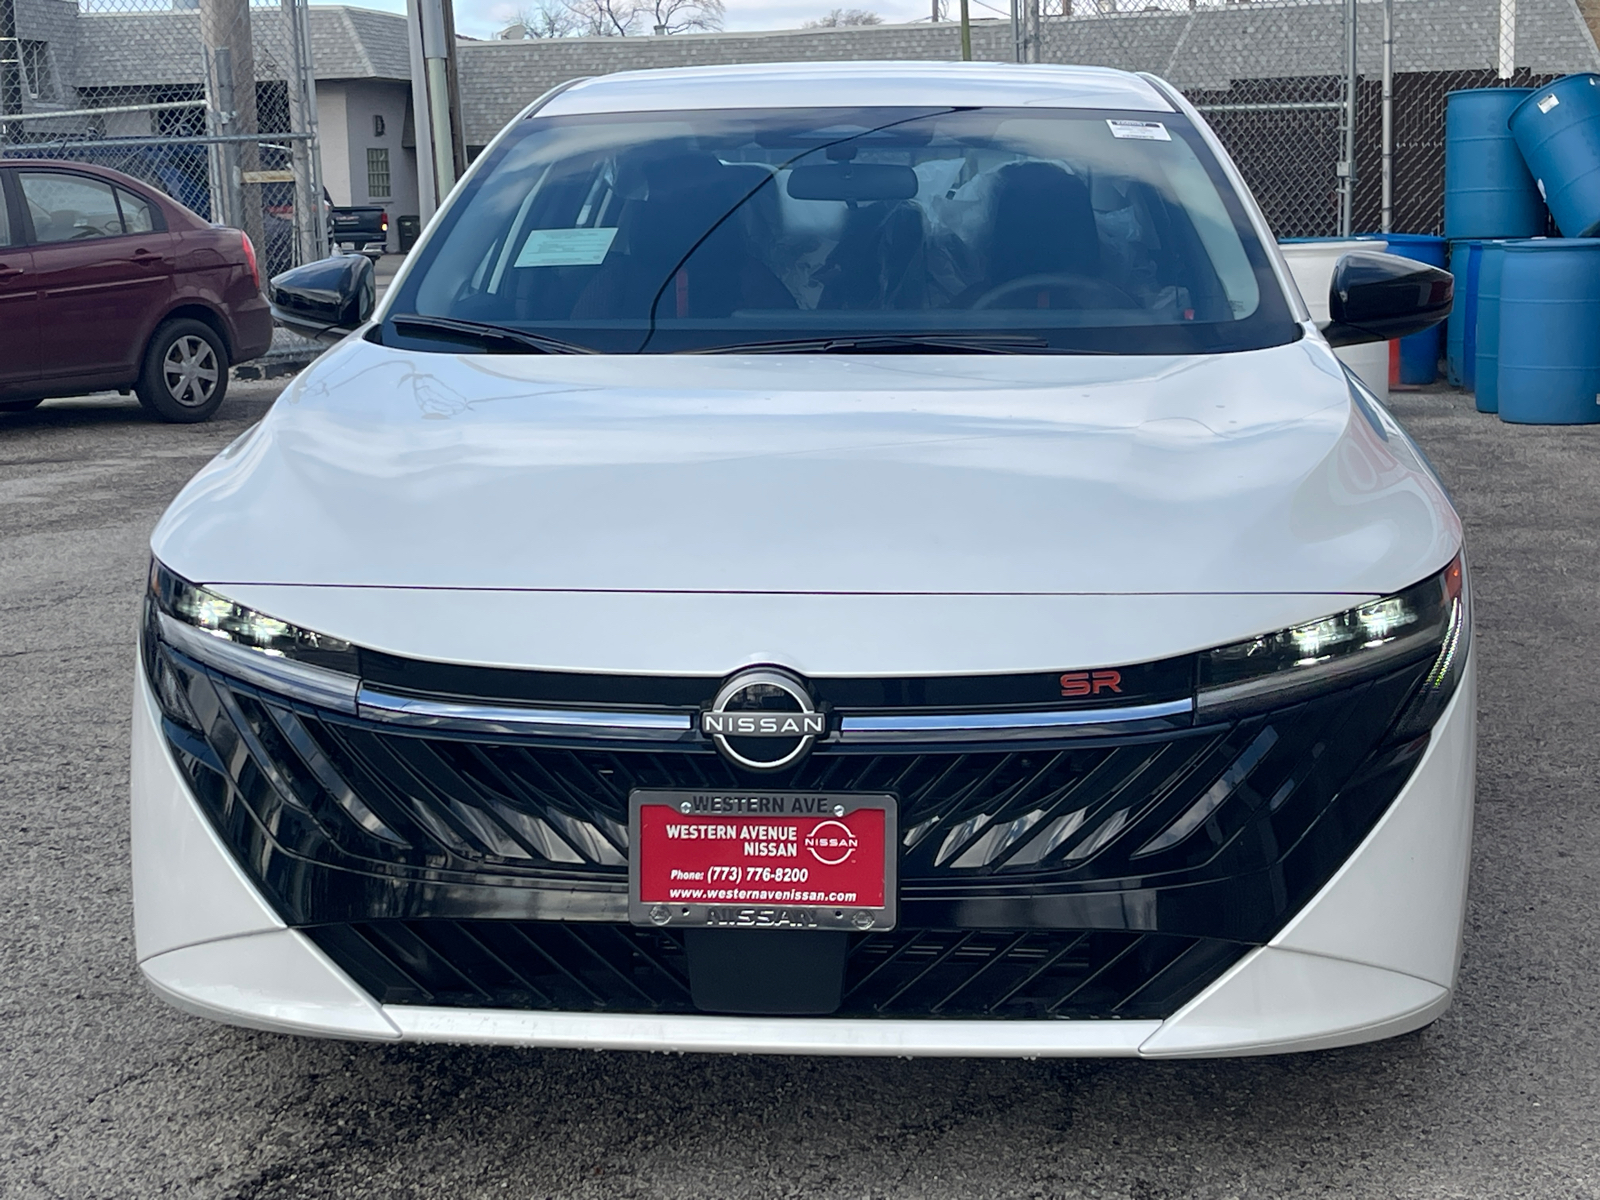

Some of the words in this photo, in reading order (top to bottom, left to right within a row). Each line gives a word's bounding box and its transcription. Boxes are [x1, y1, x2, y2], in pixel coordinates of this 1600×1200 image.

[1060, 670, 1122, 696] SR
[705, 716, 822, 733] NISSAN
[692, 796, 784, 813] WESTERN
[791, 797, 833, 814] AVE.
[666, 824, 737, 840] WESTERN
[740, 825, 797, 841] AVENUE
[744, 842, 797, 857] NISSAN
[804, 838, 858, 847] NISSAN
[670, 869, 704, 881] Phone:
[707, 866, 742, 884] (773)
[746, 867, 809, 882] 776-8200
[669, 888, 857, 902] www.westernavenissan.com
[706, 907, 817, 927] NISSAN
